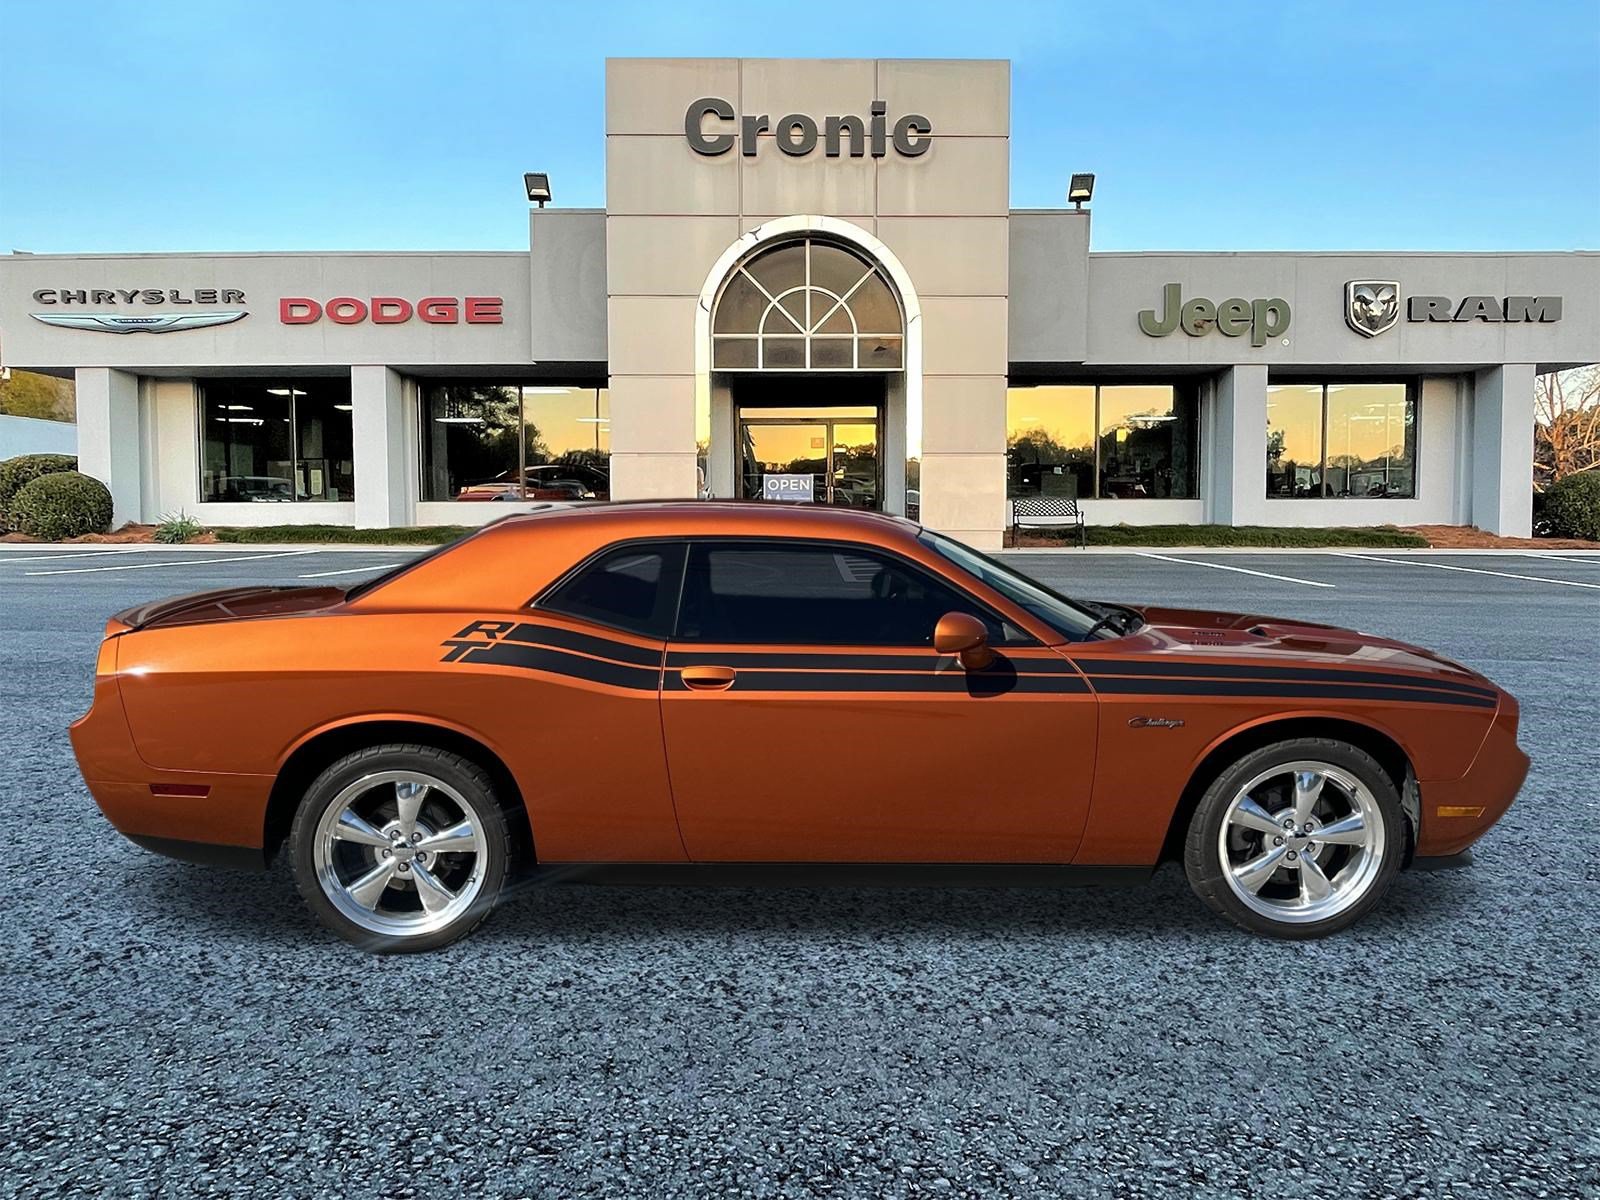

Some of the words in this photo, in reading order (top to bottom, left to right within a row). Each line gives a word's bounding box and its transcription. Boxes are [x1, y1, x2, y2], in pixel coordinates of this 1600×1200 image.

[685, 97, 932, 157] Cronic
[32, 288, 246, 305] CHRYSLER
[1407, 296, 1563, 322] RAM
[279, 296, 504, 325] DODGE
[1138, 282, 1291, 347] Jeep
[767, 479, 810, 490] OPEN
